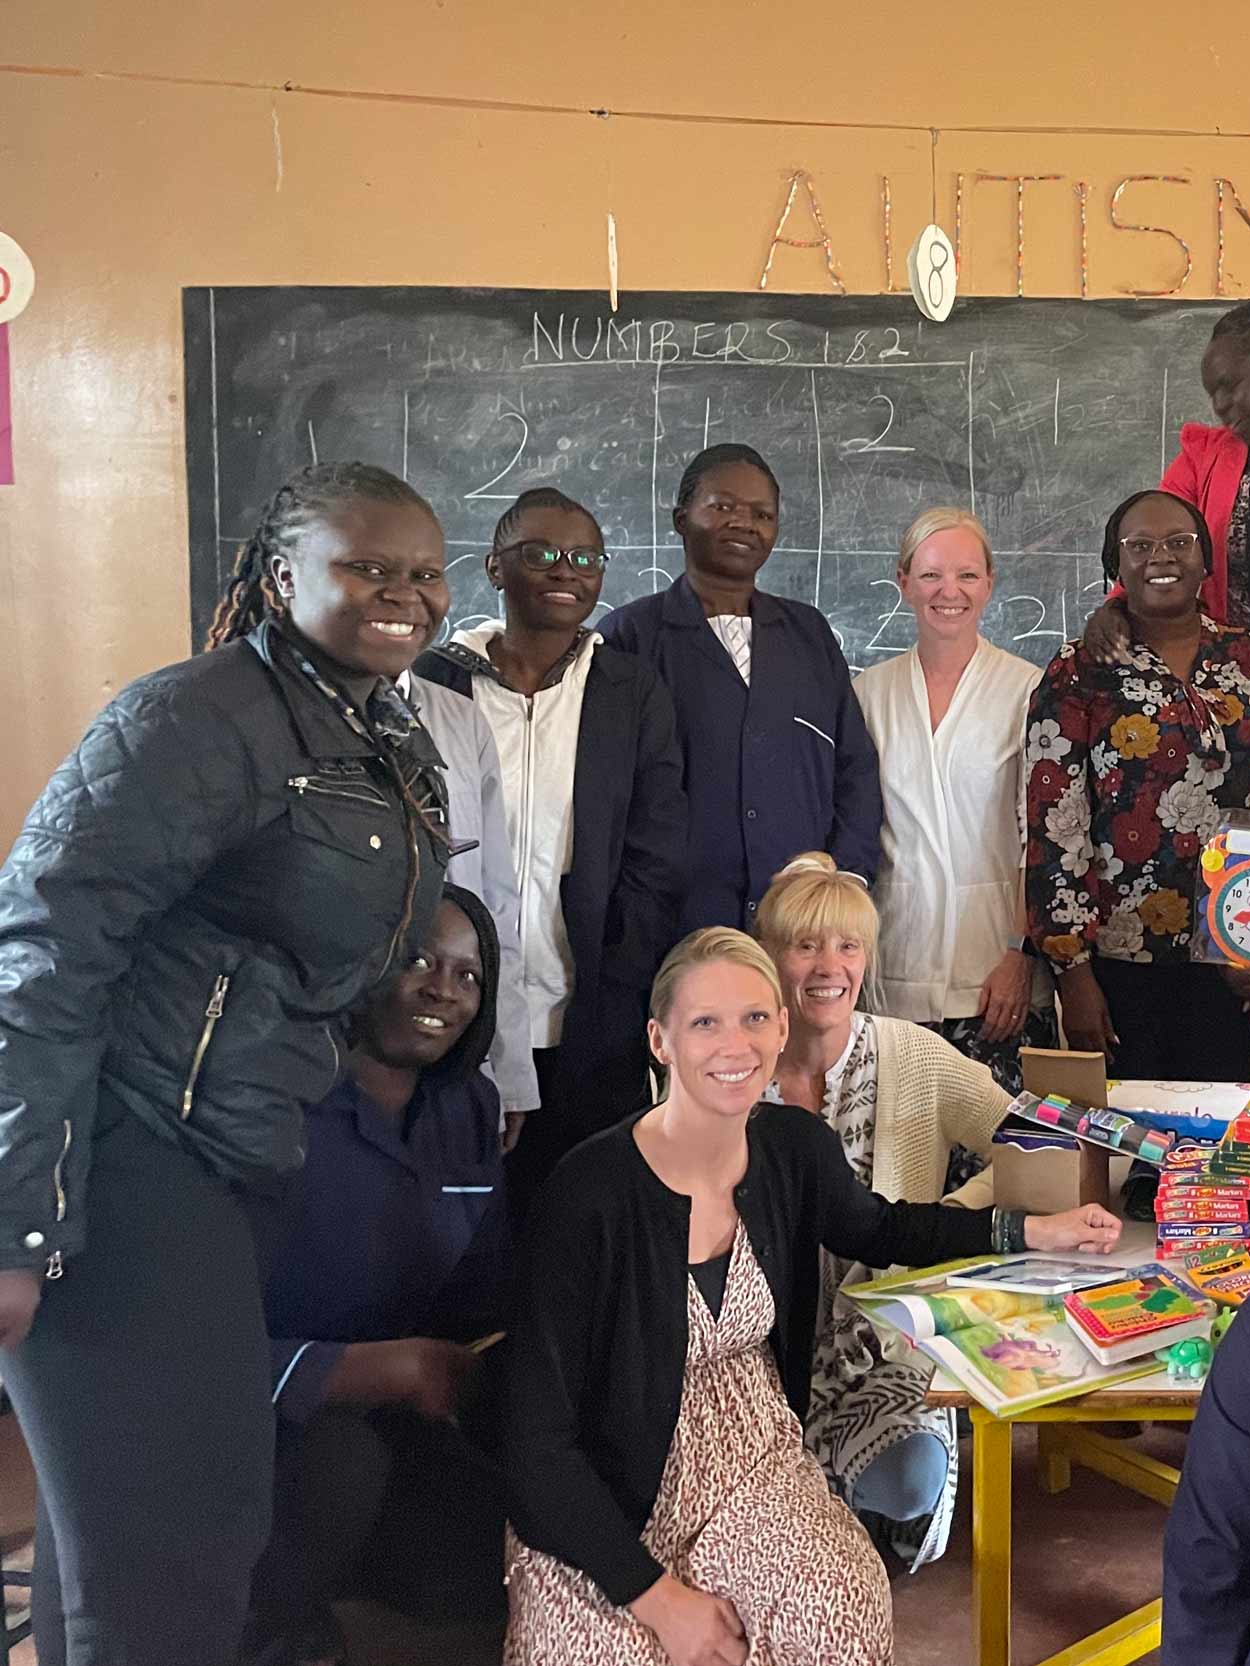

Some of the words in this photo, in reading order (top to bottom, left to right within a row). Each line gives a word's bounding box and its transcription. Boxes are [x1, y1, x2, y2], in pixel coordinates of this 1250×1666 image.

[928, 240, 949, 309] 8
[533, 312, 792, 364] NUMBERS
[878, 328, 909, 357] 2
[464, 411, 528, 498] 2
[841, 395, 916, 455] 2
[1232, 889, 1242, 898] 10
[1228, 922, 1234, 930] 8
